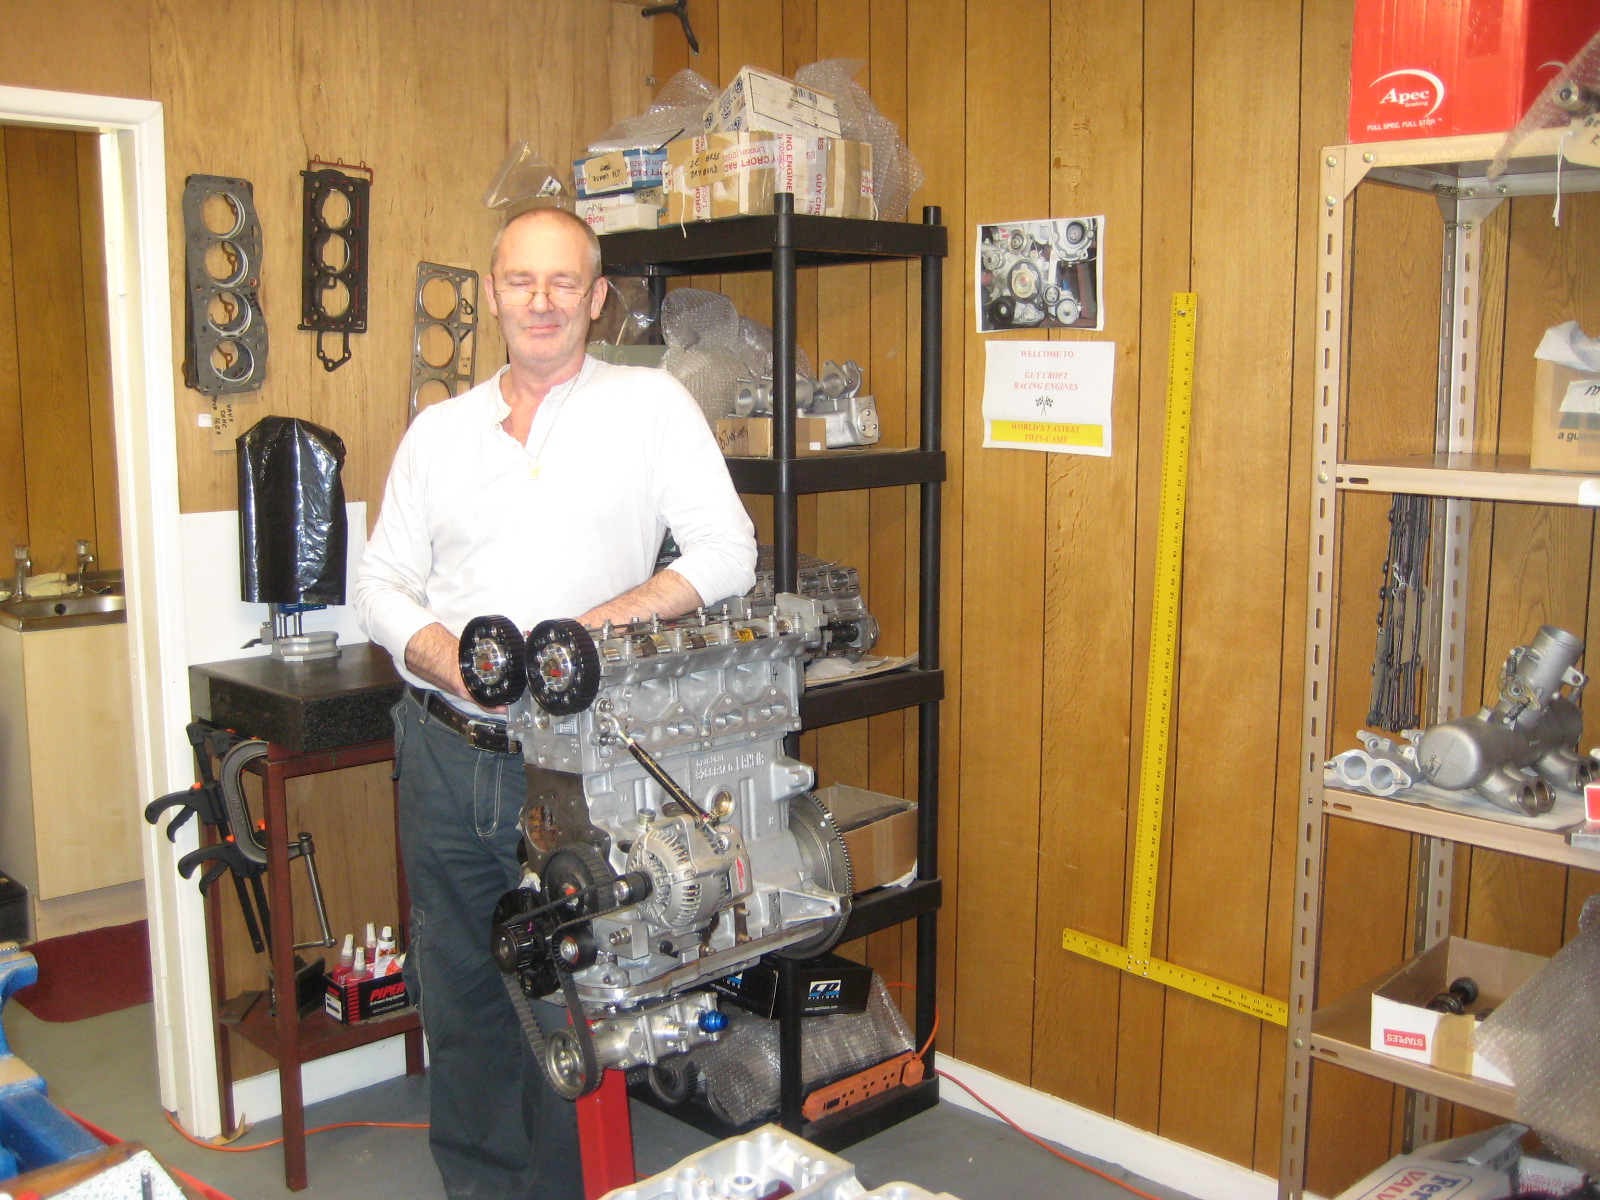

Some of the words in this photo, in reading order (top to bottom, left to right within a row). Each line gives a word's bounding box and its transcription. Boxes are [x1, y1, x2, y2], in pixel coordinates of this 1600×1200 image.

[1379, 87, 1430, 105] Apec
[1367, 122, 1382, 131] FULL
[1383, 121, 1401, 130] SPEC.
[1402, 119, 1417, 129] FULL
[740, 155, 770, 167] CROFT
[785, 154, 793, 191] ENGINE
[1020, 350, 1061, 358] WELCOME
[1063, 350, 1074, 358] TO
[1024, 371, 1041, 379] GUY
[1042, 371, 1069, 380] CROFT
[1013, 382, 1043, 390] RACING
[1044, 382, 1079, 391] ENGINES
[1011, 423, 1045, 431] WORLD'S
[1047, 425, 1080, 433] FASTEST
[1024, 434, 1068, 443] TWIN-CAMS
[369, 982, 407, 1002] PIPER
[1386, 1033, 1424, 1047] STAPLES
[1375, 1170, 1428, 1200] VALV
